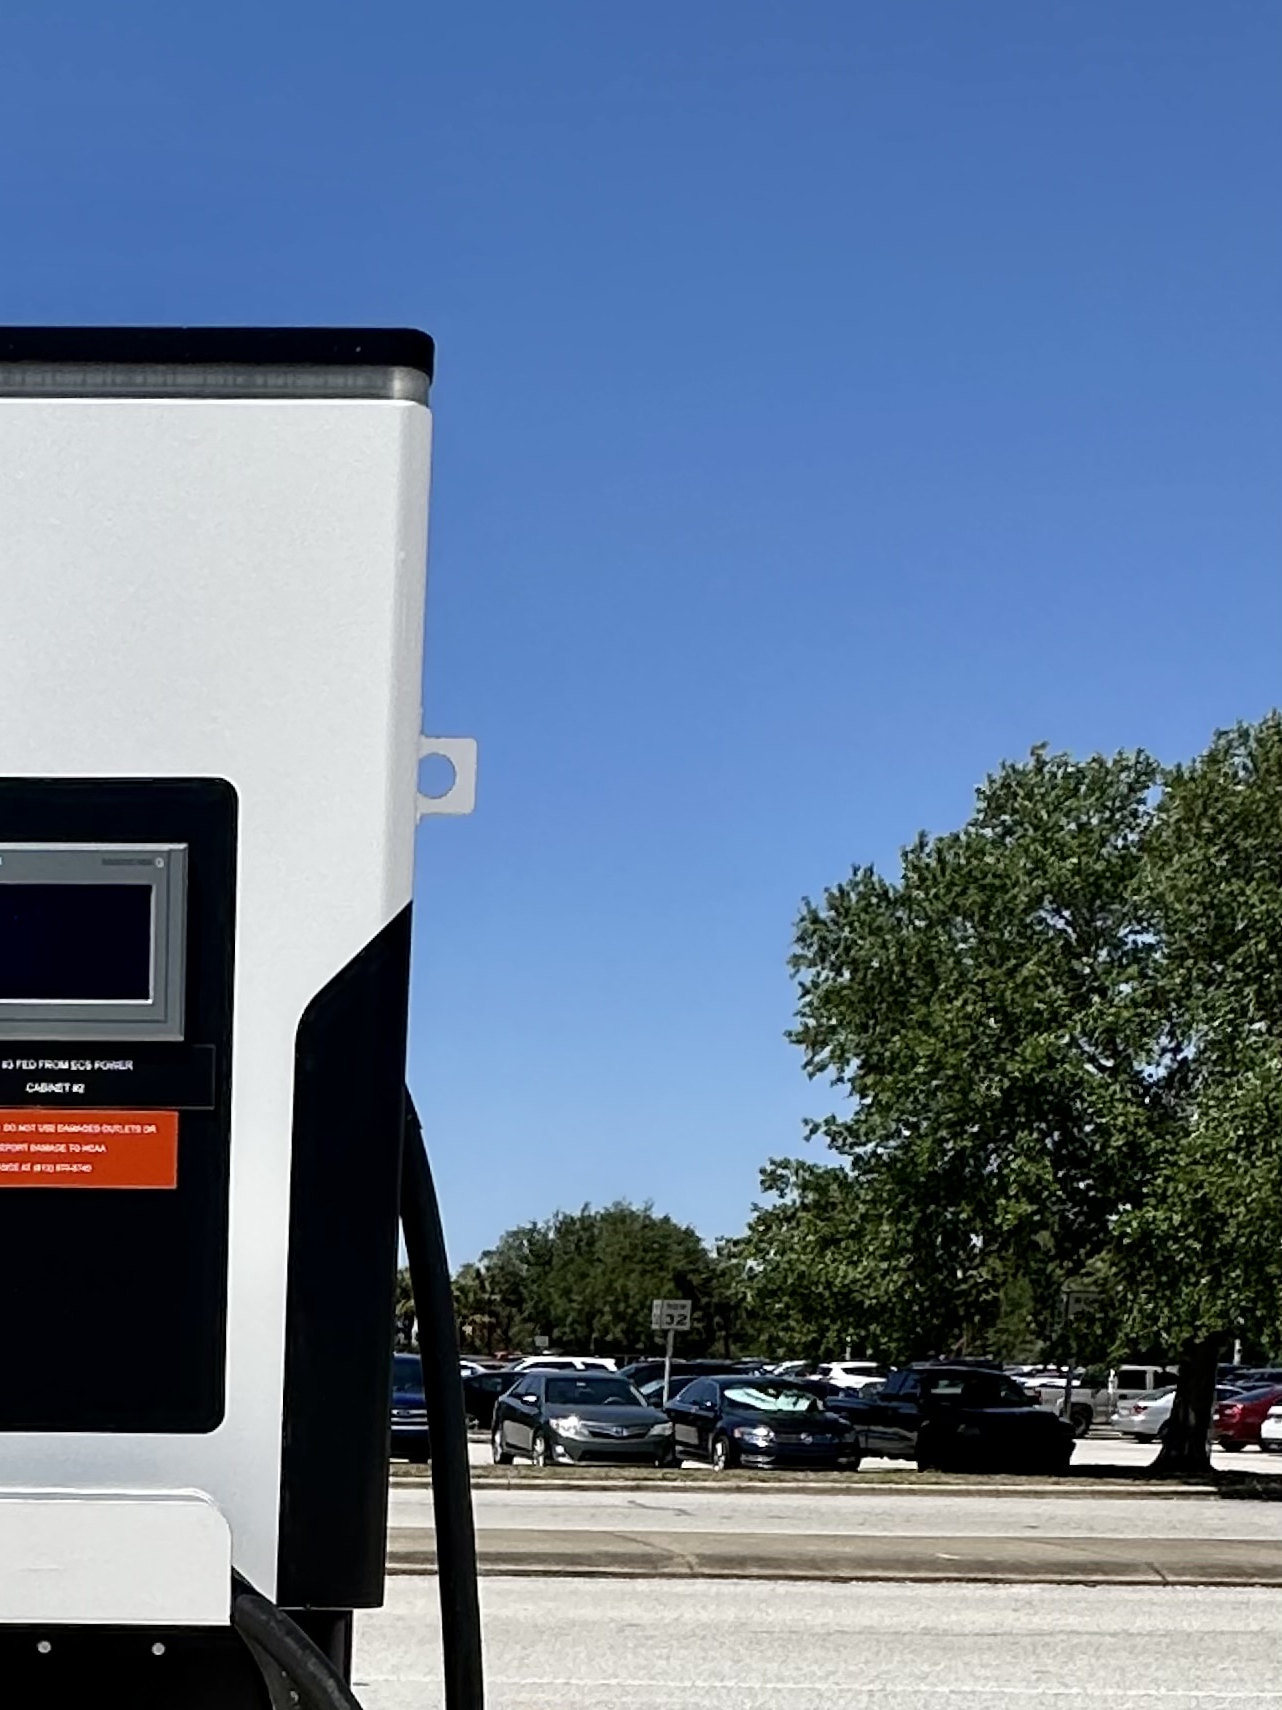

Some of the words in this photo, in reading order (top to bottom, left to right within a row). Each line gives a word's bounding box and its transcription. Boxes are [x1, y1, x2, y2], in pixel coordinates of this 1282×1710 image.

[16, 1059, 37, 1070] FED
[38, 1059, 69, 1071] FROM
[94, 1060, 134, 1071] POWER
[25, 1082, 71, 1094] CABINET
[3, 1123, 17, 1132] DO
[18, 1123, 36, 1133] NOT
[37, 1123, 56, 1133] USE
[57, 1123, 101, 1133] DAMAGED
[102, 1124, 142, 1134] OUTLETS
[143, 1124, 157, 1134] OR
[30, 1143, 67, 1153] DAMAGE
[68, 1143, 81, 1153] TO
[21, 1162, 31, 1172] AT
